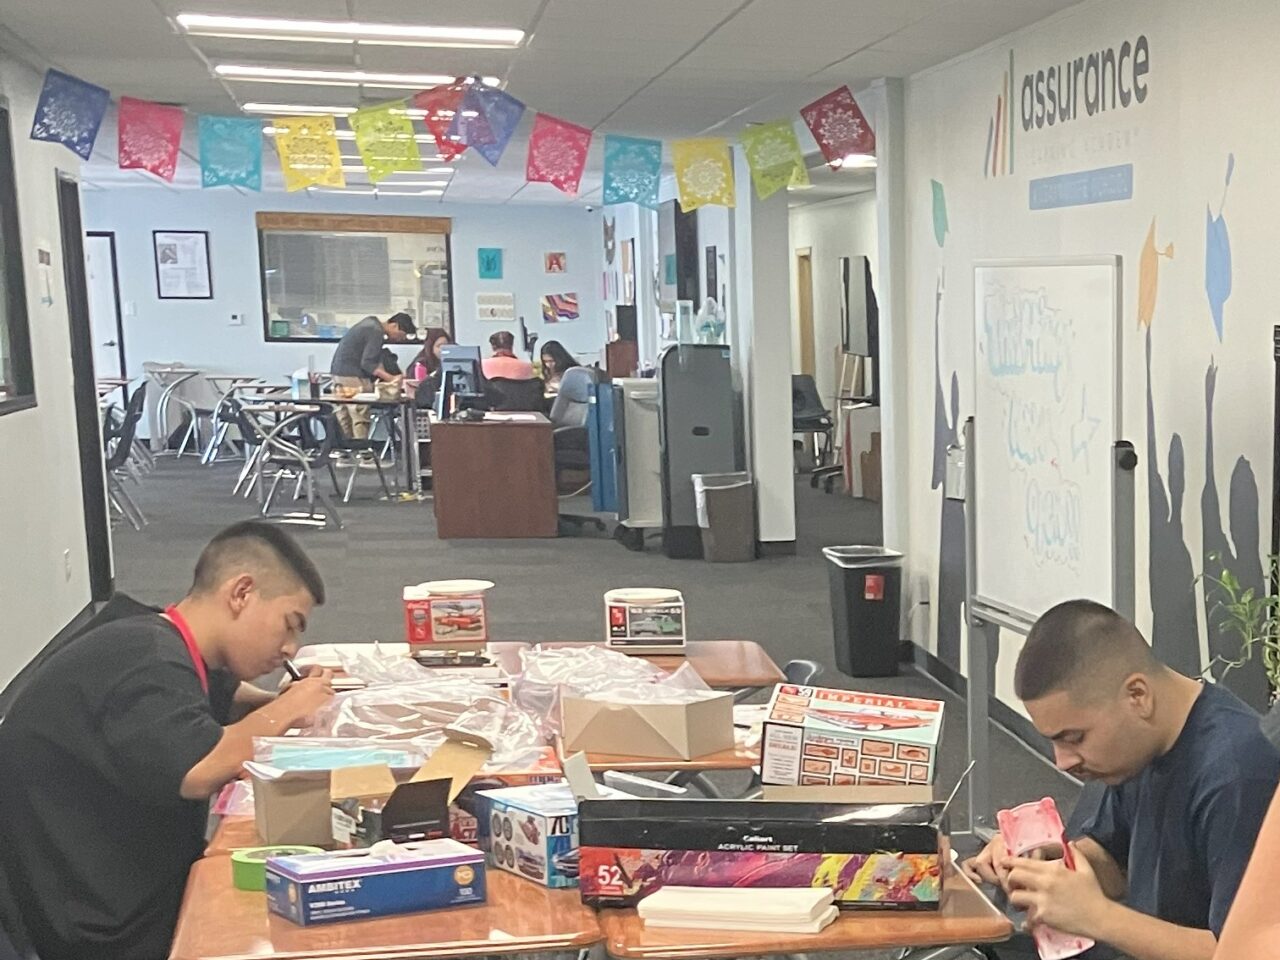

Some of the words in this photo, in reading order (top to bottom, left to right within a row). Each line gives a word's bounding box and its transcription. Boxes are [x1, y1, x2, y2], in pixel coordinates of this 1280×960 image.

[1021, 34, 1149, 132] assurance
[819, 691, 908, 709] IMPERIAL
[718, 843, 754, 851] ACRYLIC
[756, 844, 781, 852] PAINT
[782, 844, 799, 852] SET
[598, 864, 623, 885] 52
[308, 880, 361, 893] AMBITEX
